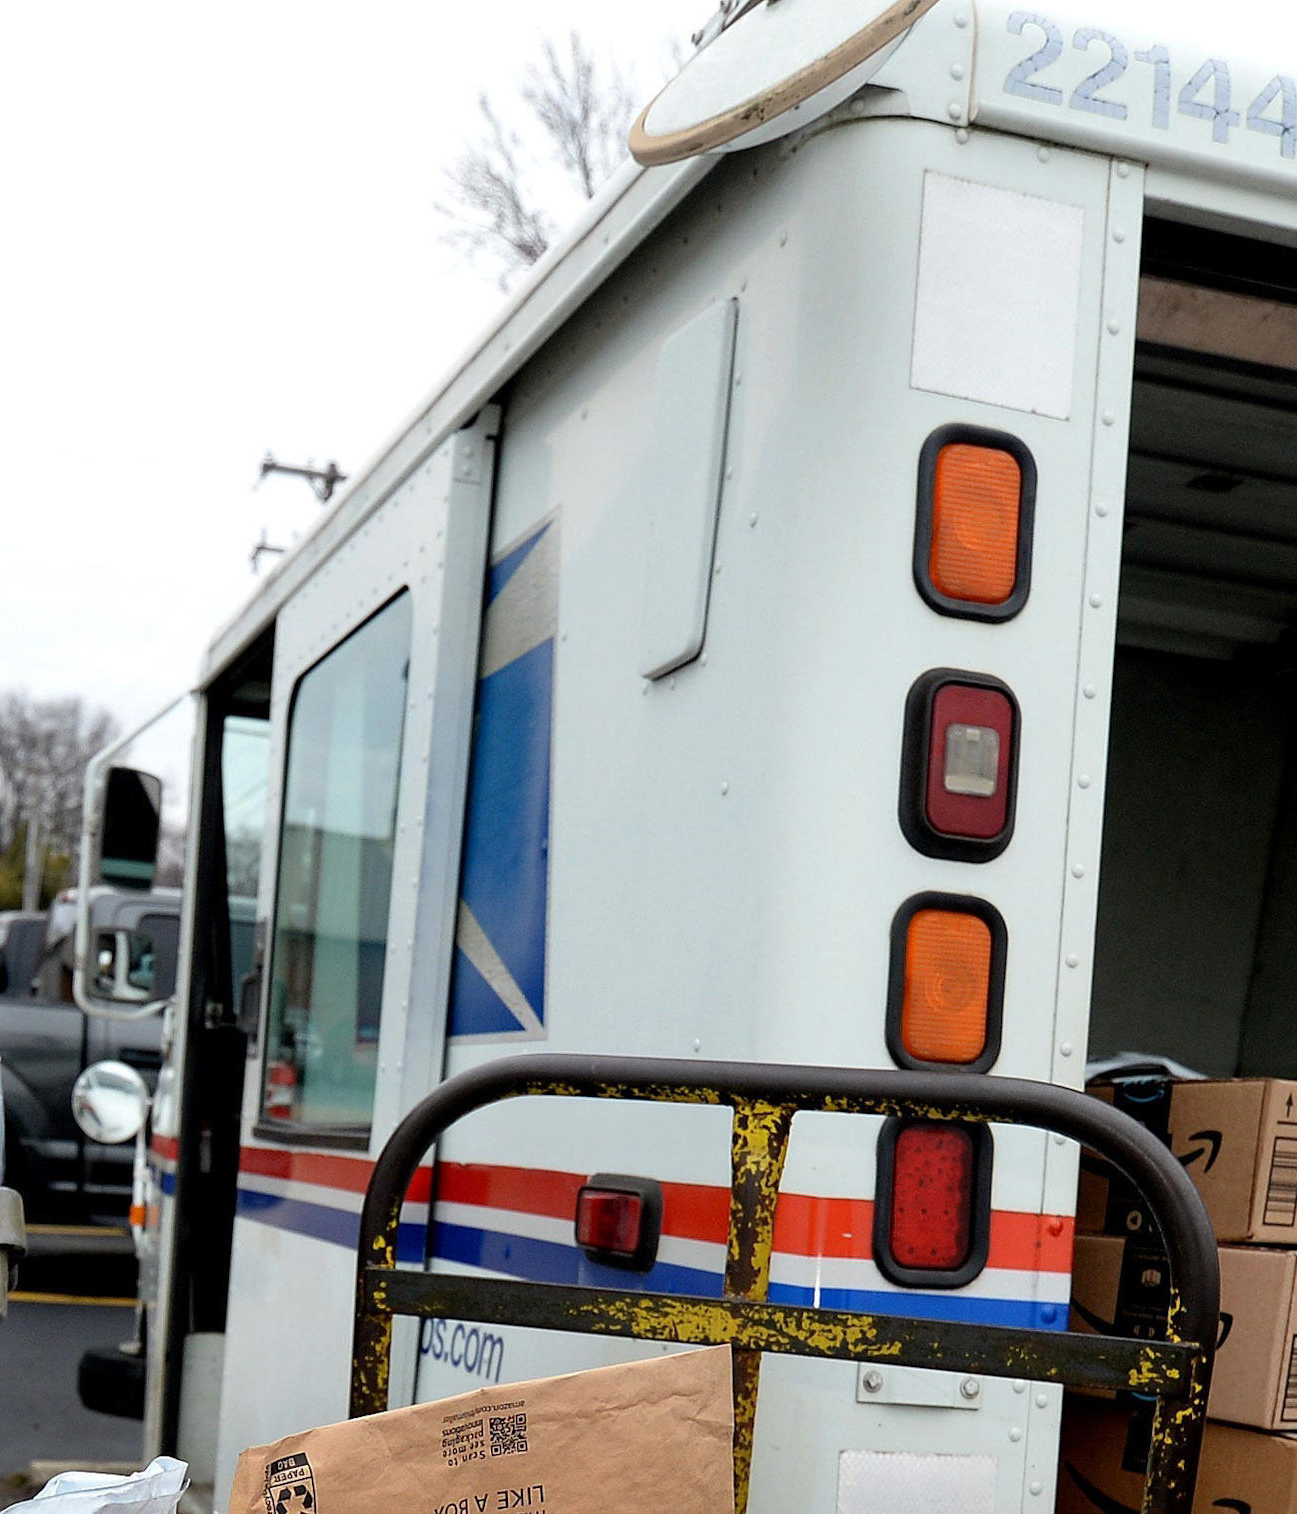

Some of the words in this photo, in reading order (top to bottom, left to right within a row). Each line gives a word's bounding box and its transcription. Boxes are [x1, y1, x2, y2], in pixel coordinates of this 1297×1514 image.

[469, 1439, 485, 1450] see
[442, 1446, 467, 1458] more
[462, 1449, 486, 1463] Scan
[447, 1457, 458, 1466] to
[273, 1468, 305, 1483] PAPER
[474, 1493, 489, 1513] A
[497, 1484, 545, 1510] LIKE
